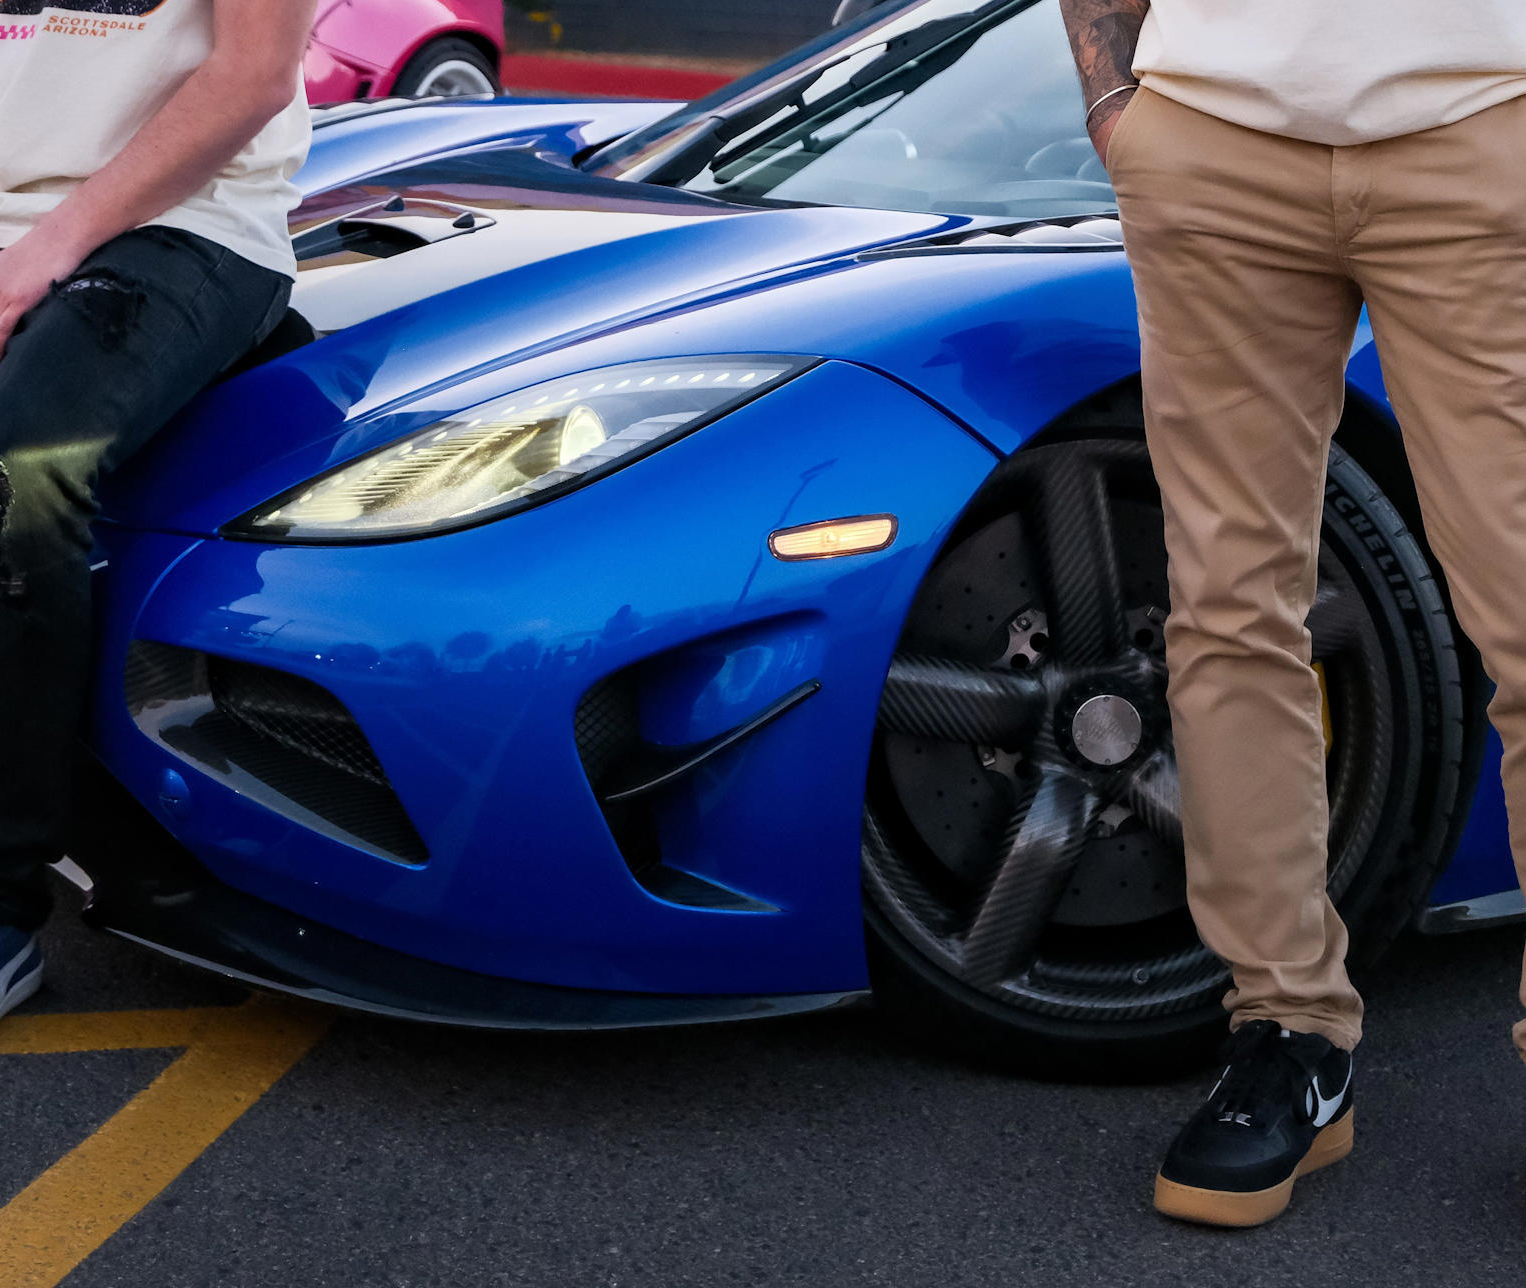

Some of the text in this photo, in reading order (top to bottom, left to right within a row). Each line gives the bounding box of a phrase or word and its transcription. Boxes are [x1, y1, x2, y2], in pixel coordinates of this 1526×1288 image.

[42, 23, 108, 38] ARIZONA
[48, 15, 146, 31] SCOTTSDALE
[1325, 482, 1418, 610] ICHELIN
